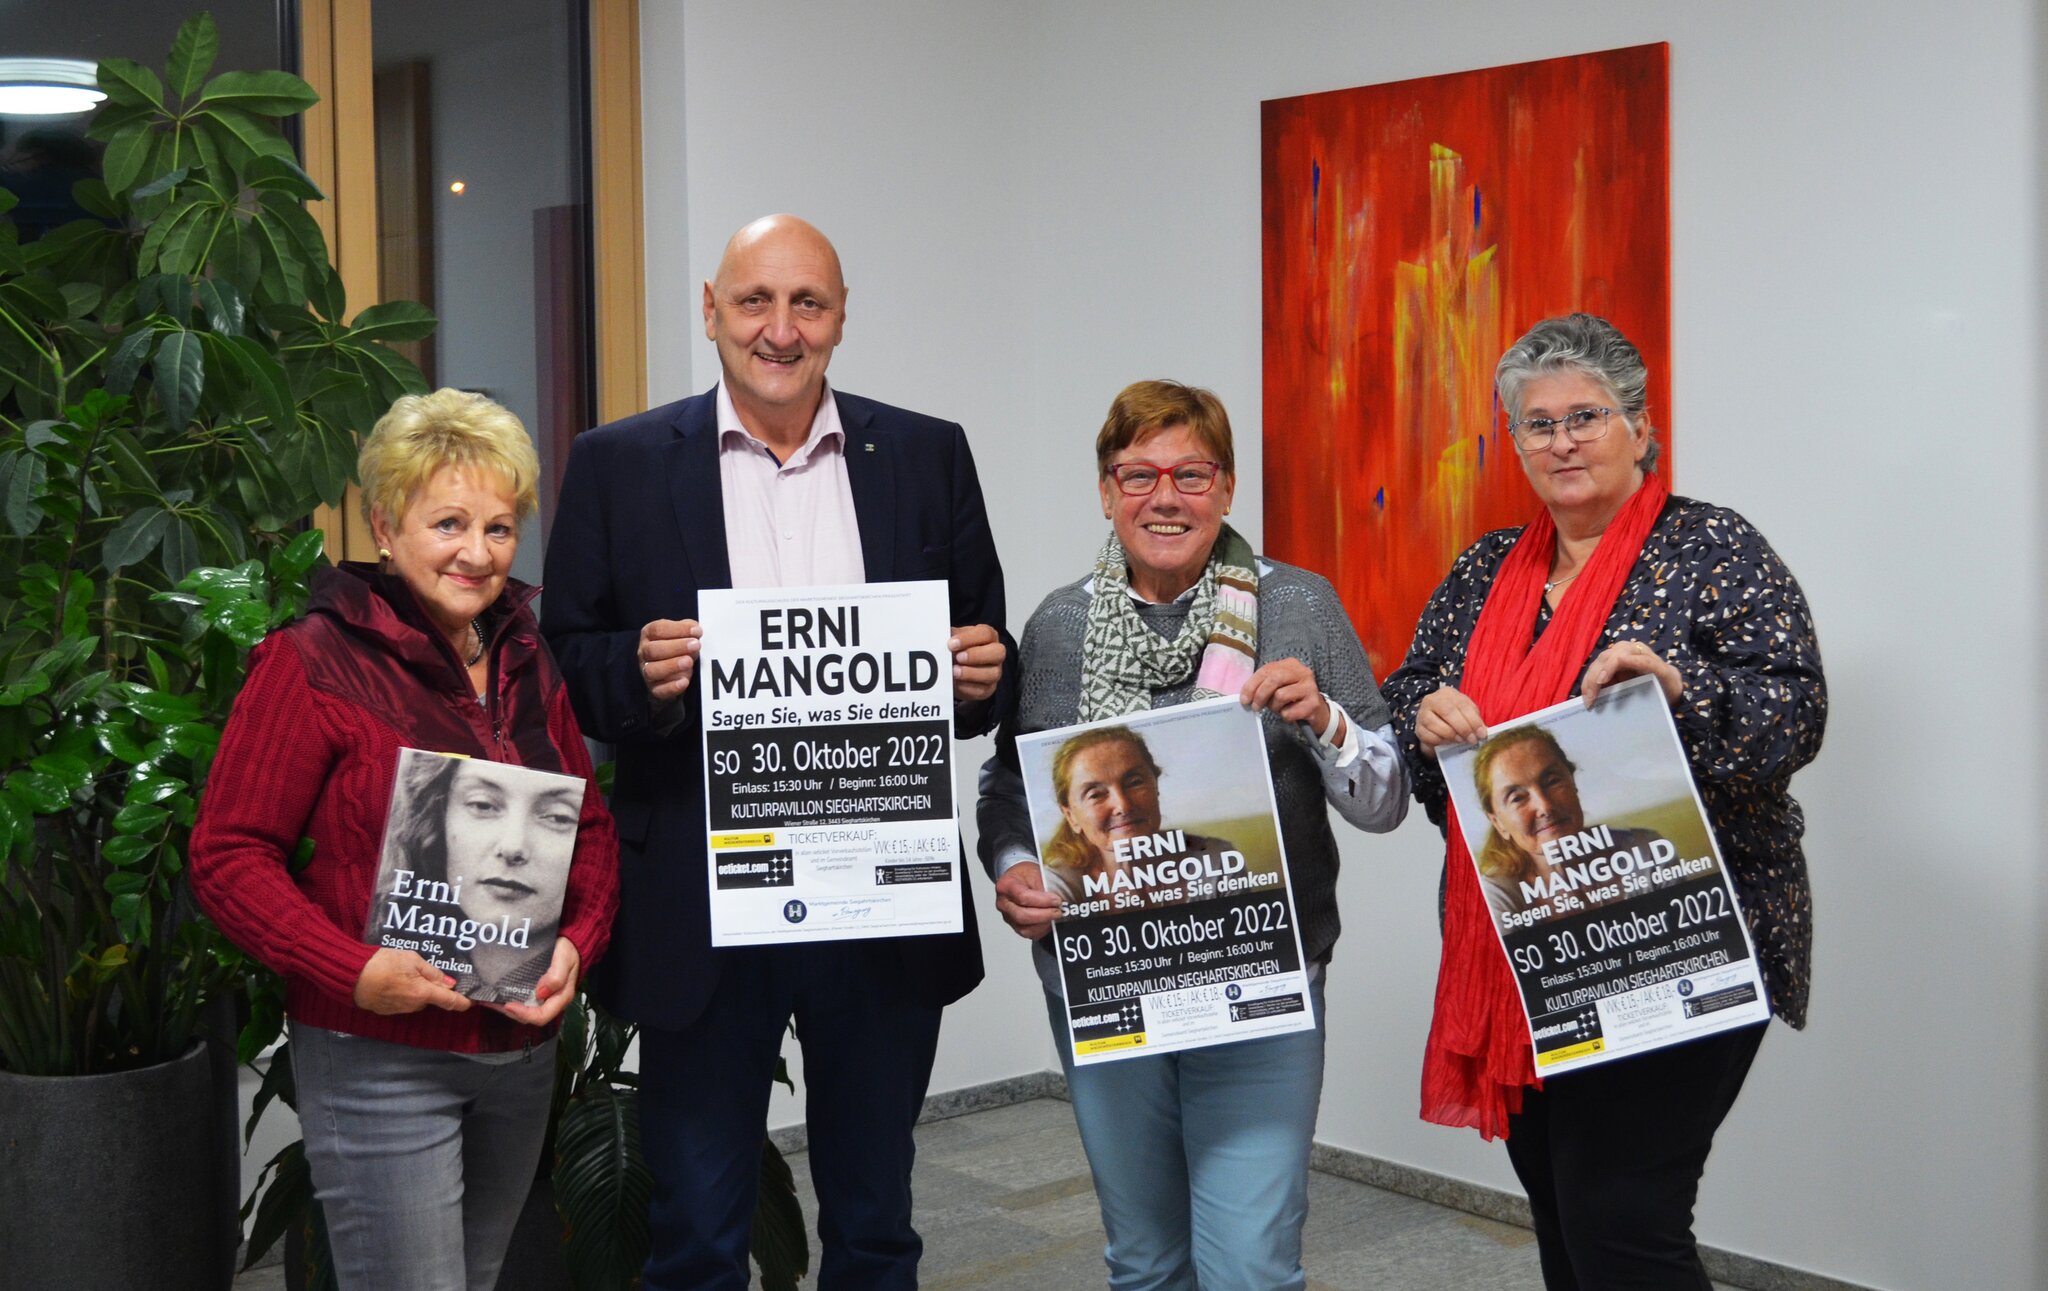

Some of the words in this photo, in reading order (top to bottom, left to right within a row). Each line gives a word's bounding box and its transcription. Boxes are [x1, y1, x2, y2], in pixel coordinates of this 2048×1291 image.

[760, 606, 860, 650] ERNI
[711, 651, 939, 700] MANGOLD
[712, 709, 765, 729] Sagen
[771, 707, 801, 725] Sie,
[808, 707, 841, 722] was
[848, 704, 873, 720] Sie
[879, 702, 941, 718] denken
[713, 750, 740, 775] SO
[752, 742, 787, 773] 30.
[793, 739, 880, 771] Oktober
[887, 734, 944, 766] 2022
[732, 781, 770, 794] Einlass:
[773, 779, 801, 793] 15:30
[804, 778, 823, 790] Uhr
[839, 776, 877, 792] Beginn:
[879, 775, 908, 787] 16:00
[910, 774, 928, 785] Uhr
[731, 800, 823, 819] KULTURPAVILLON
[825, 794, 931, 814] SIEGHARTSKIRCHEN
[788, 830, 877, 844] TICKETVERKAUF:
[1112, 829, 1187, 863] ERNI
[1541, 824, 1614, 866] ERNI
[390, 868, 463, 905] Erni
[718, 862, 769, 875] oeticket.com
[1082, 850, 1245, 898] MANGOLD
[1519, 838, 1675, 904] MANGOLD
[1060, 896, 1110, 918] Sagen
[1114, 892, 1145, 911] Sie,
[1149, 888, 1183, 904] was
[1187, 880, 1213, 897] Sie
[1217, 870, 1279, 893] denken
[1501, 904, 1551, 929] Sagen
[1554, 894, 1585, 914] Sie,
[1588, 884, 1620, 903] was
[1622, 873, 1648, 893] Sie
[1651, 854, 1712, 884] denken
[381, 934, 420, 950] Sagen
[421, 940, 444, 955] Sie,
[382, 901, 531, 951] Mangold
[1063, 934, 1092, 963] SO
[1101, 924, 1137, 957] 30.
[1141, 913, 1225, 948] Oktober
[1230, 900, 1288, 936] 2022
[1514, 945, 1543, 973] SO
[1548, 929, 1586, 963] 30.
[1586, 908, 1669, 952] Oktober
[1670, 886, 1731, 929] 2022
[426, 955, 473, 974] denken
[1086, 964, 1122, 979] Einlass:
[1125, 959, 1152, 973] 15:30
[1153, 956, 1172, 969] Uhr
[1187, 948, 1224, 965] Beginn:
[1226, 943, 1254, 957] 16:00
[1255, 940, 1274, 953] Uhr
[1541, 971, 1576, 988] Einlass:
[1577, 961, 1603, 979] 15:30
[1605, 957, 1622, 971] Uhr
[1636, 943, 1671, 962] Beginn:
[1673, 936, 1700, 952] 16:00
[1701, 929, 1720, 945] Uhr
[1087, 979, 1176, 1002] KULTURPAVILLON
[1177, 959, 1280, 990] SIEGHARTSKIRCHEN
[1545, 979, 1629, 1012] KULTURPAVILLON
[1629, 949, 1729, 989] SIEGHARTSKIRCHEN
[1072, 1012, 1120, 1029] oeticket.com
